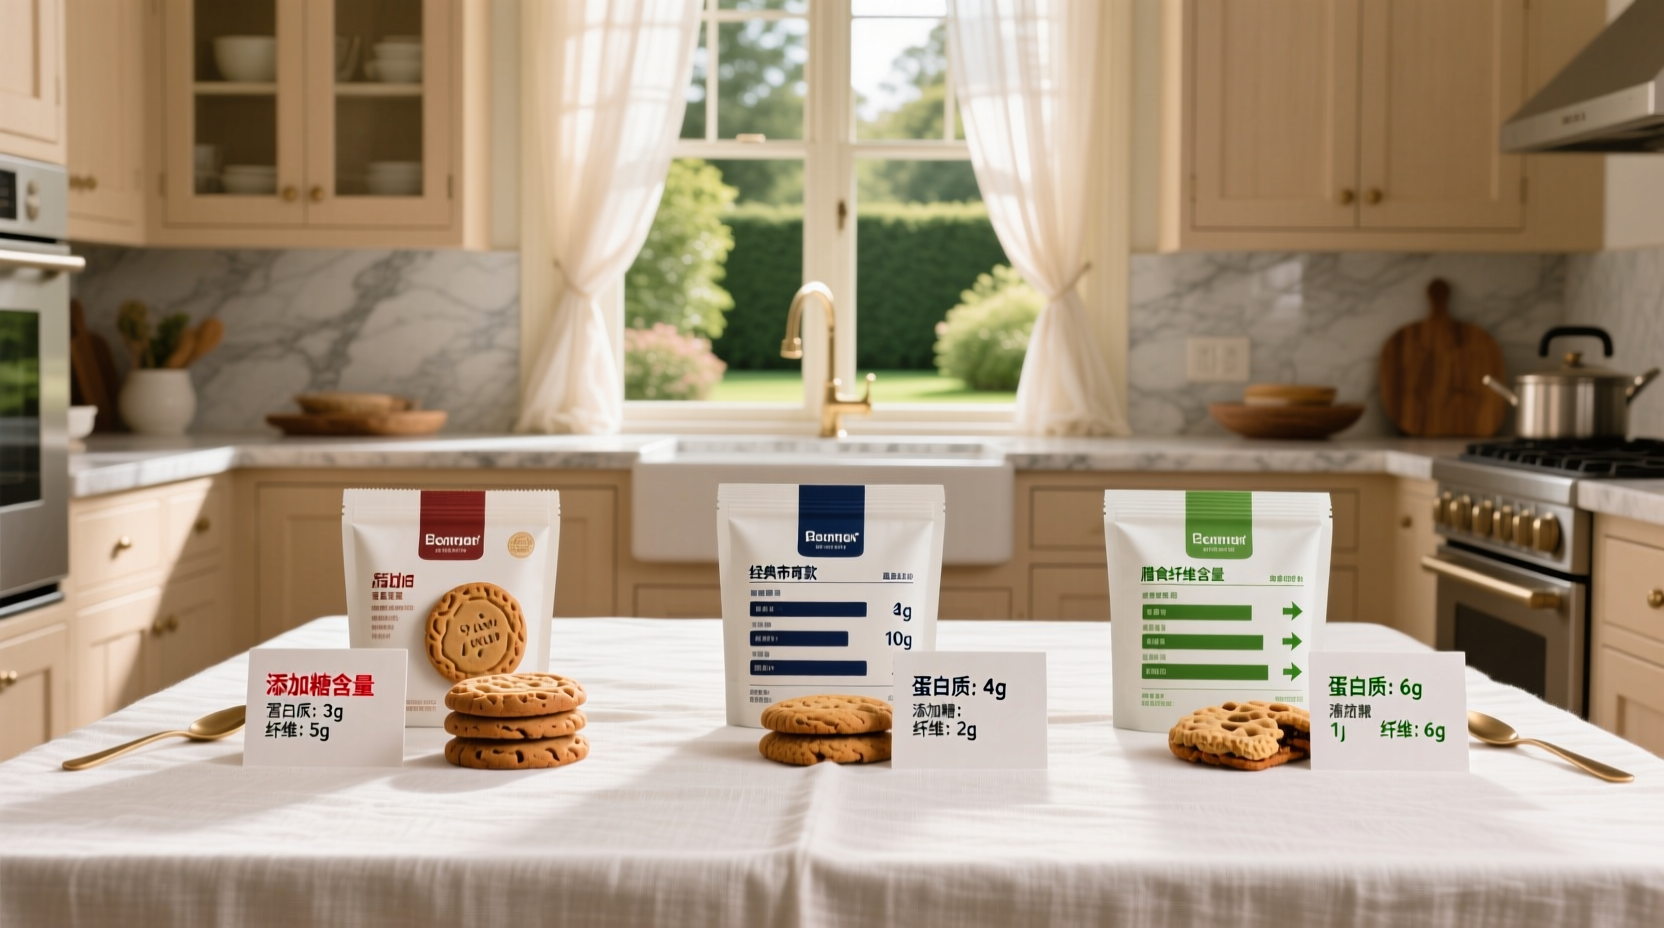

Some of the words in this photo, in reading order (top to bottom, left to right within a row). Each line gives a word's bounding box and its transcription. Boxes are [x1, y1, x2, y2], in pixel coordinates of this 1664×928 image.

[886, 631, 911, 650] 10g
[267, 673, 374, 696] 添加糖含量
[983, 678, 1006, 700] 4g
[1400, 679, 1422, 700] 6g
[324, 704, 343, 722] 3g
[310, 723, 329, 741] 5g
[957, 721, 976, 740] 2g
[1424, 722, 1445, 742] 6g
